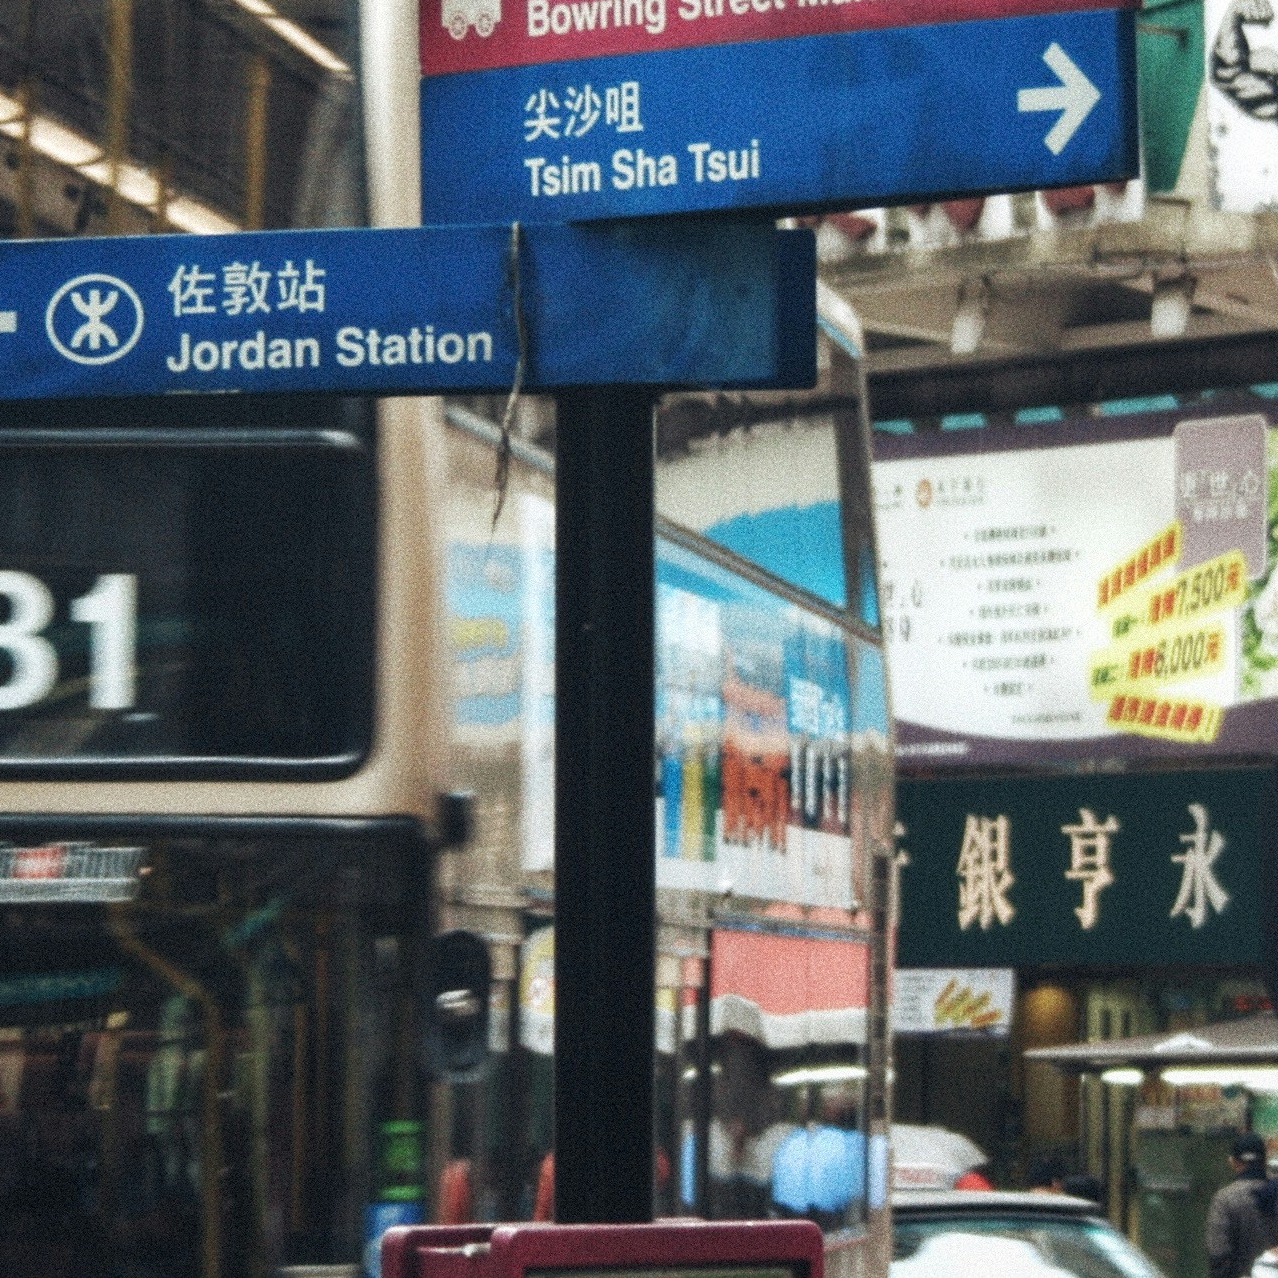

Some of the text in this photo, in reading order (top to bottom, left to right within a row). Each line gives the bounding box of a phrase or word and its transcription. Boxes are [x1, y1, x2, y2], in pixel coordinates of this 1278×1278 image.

[524, 80, 645, 142] 尖沙咀
[524, 139, 761, 198] Tsim Sha Tsui
[167, 259, 327, 318] 佐敦站
[166, 324, 494, 375] Jordan Station
